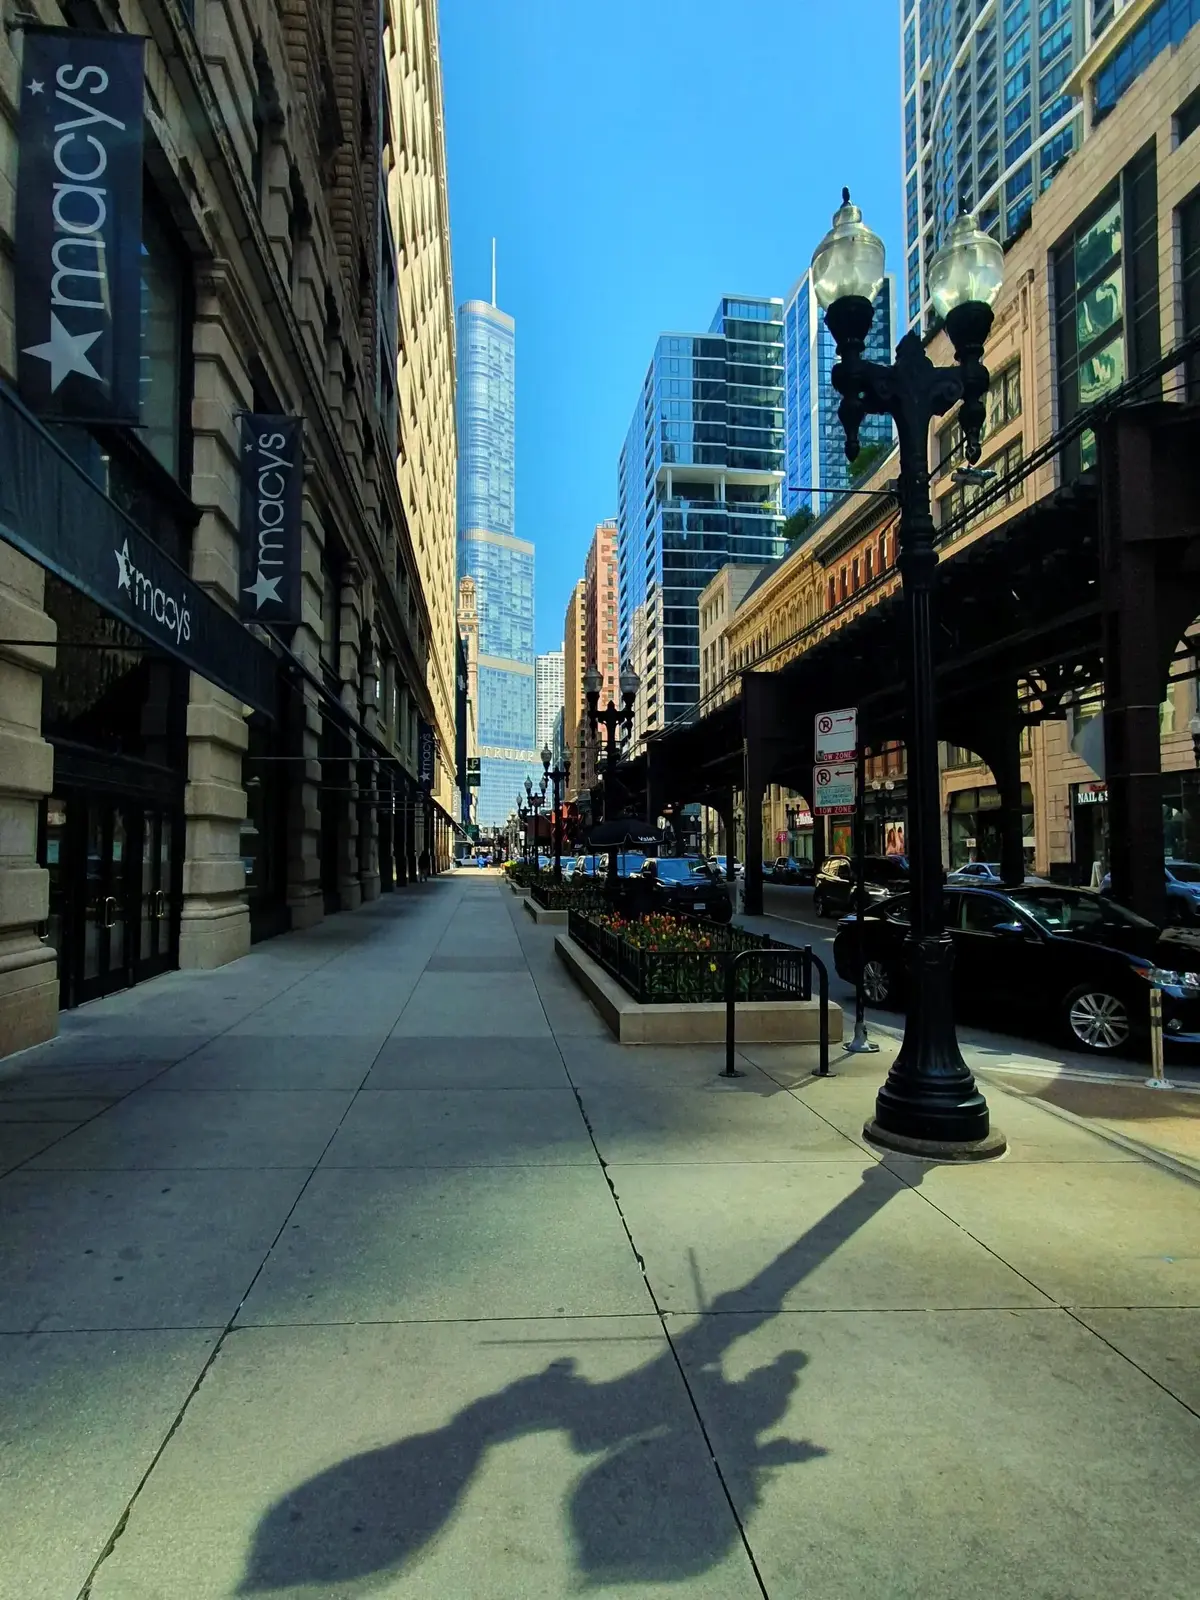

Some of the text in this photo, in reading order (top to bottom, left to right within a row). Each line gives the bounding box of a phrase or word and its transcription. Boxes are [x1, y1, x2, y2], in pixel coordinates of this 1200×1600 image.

[482, 746, 535, 762] TRUMP
[836, 751, 853, 760] ZONE
[1078, 791, 1097, 804] NAIL
[834, 805, 852, 814] ZONE
